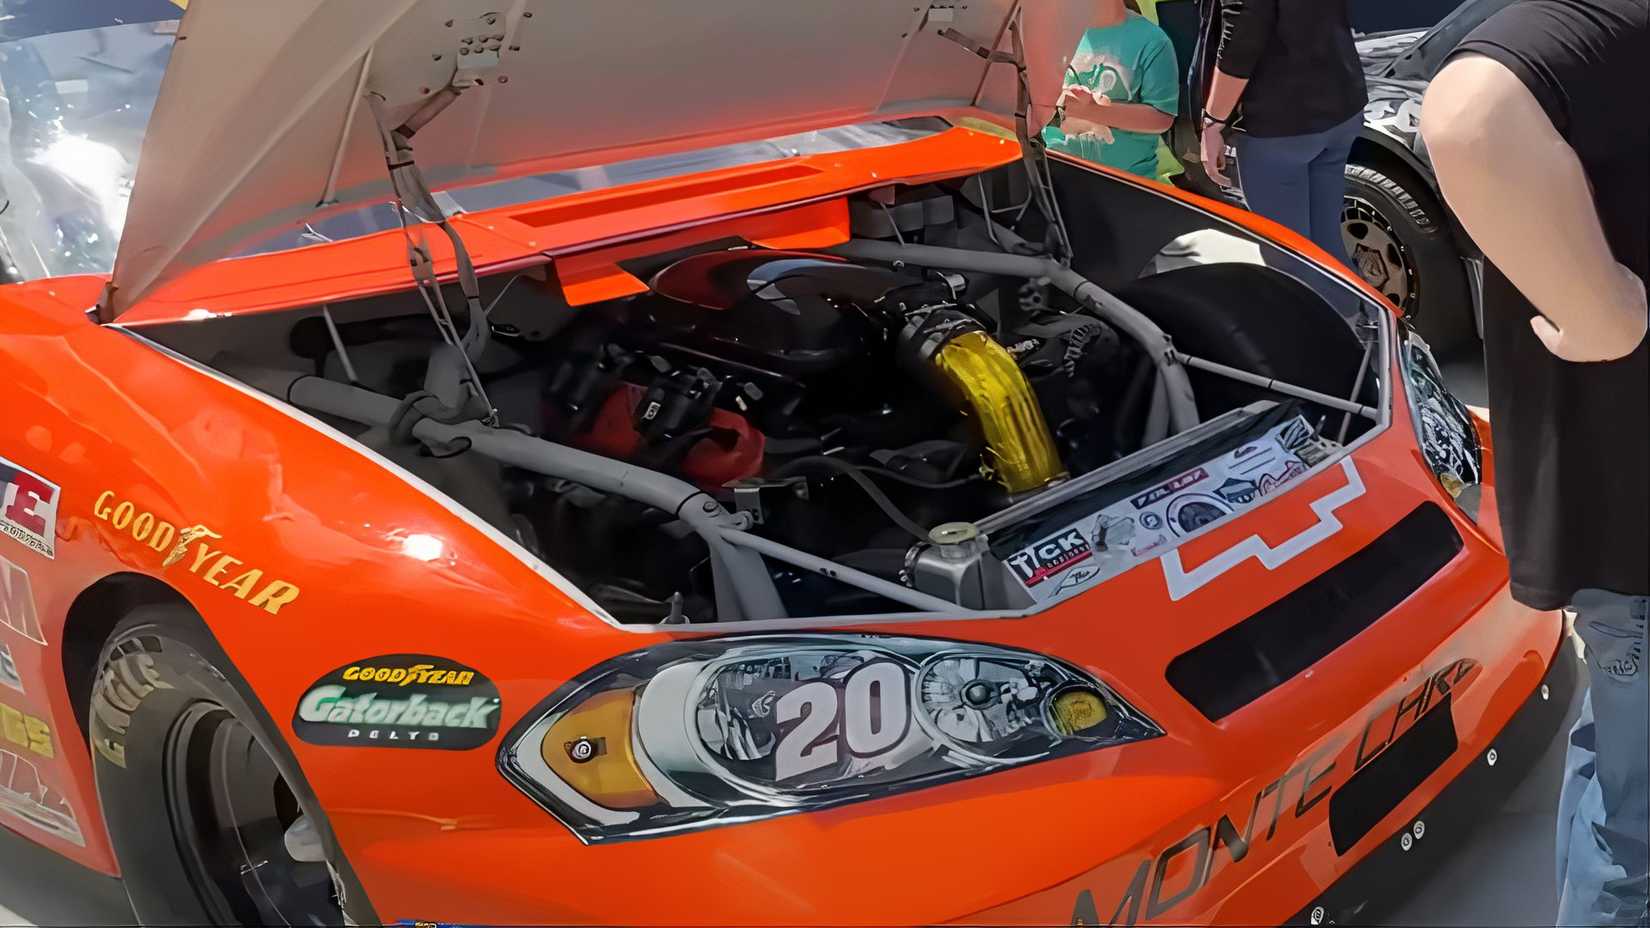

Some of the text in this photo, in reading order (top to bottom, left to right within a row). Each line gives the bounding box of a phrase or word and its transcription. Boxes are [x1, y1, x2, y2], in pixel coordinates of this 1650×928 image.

[94, 490, 300, 615] GOODYEAR
[300, 685, 500, 728] Gatorback
[342, 664, 474, 686] GOODYEAR
[776, 657, 911, 781] 20
[1071, 761, 1336, 926] MONTE
